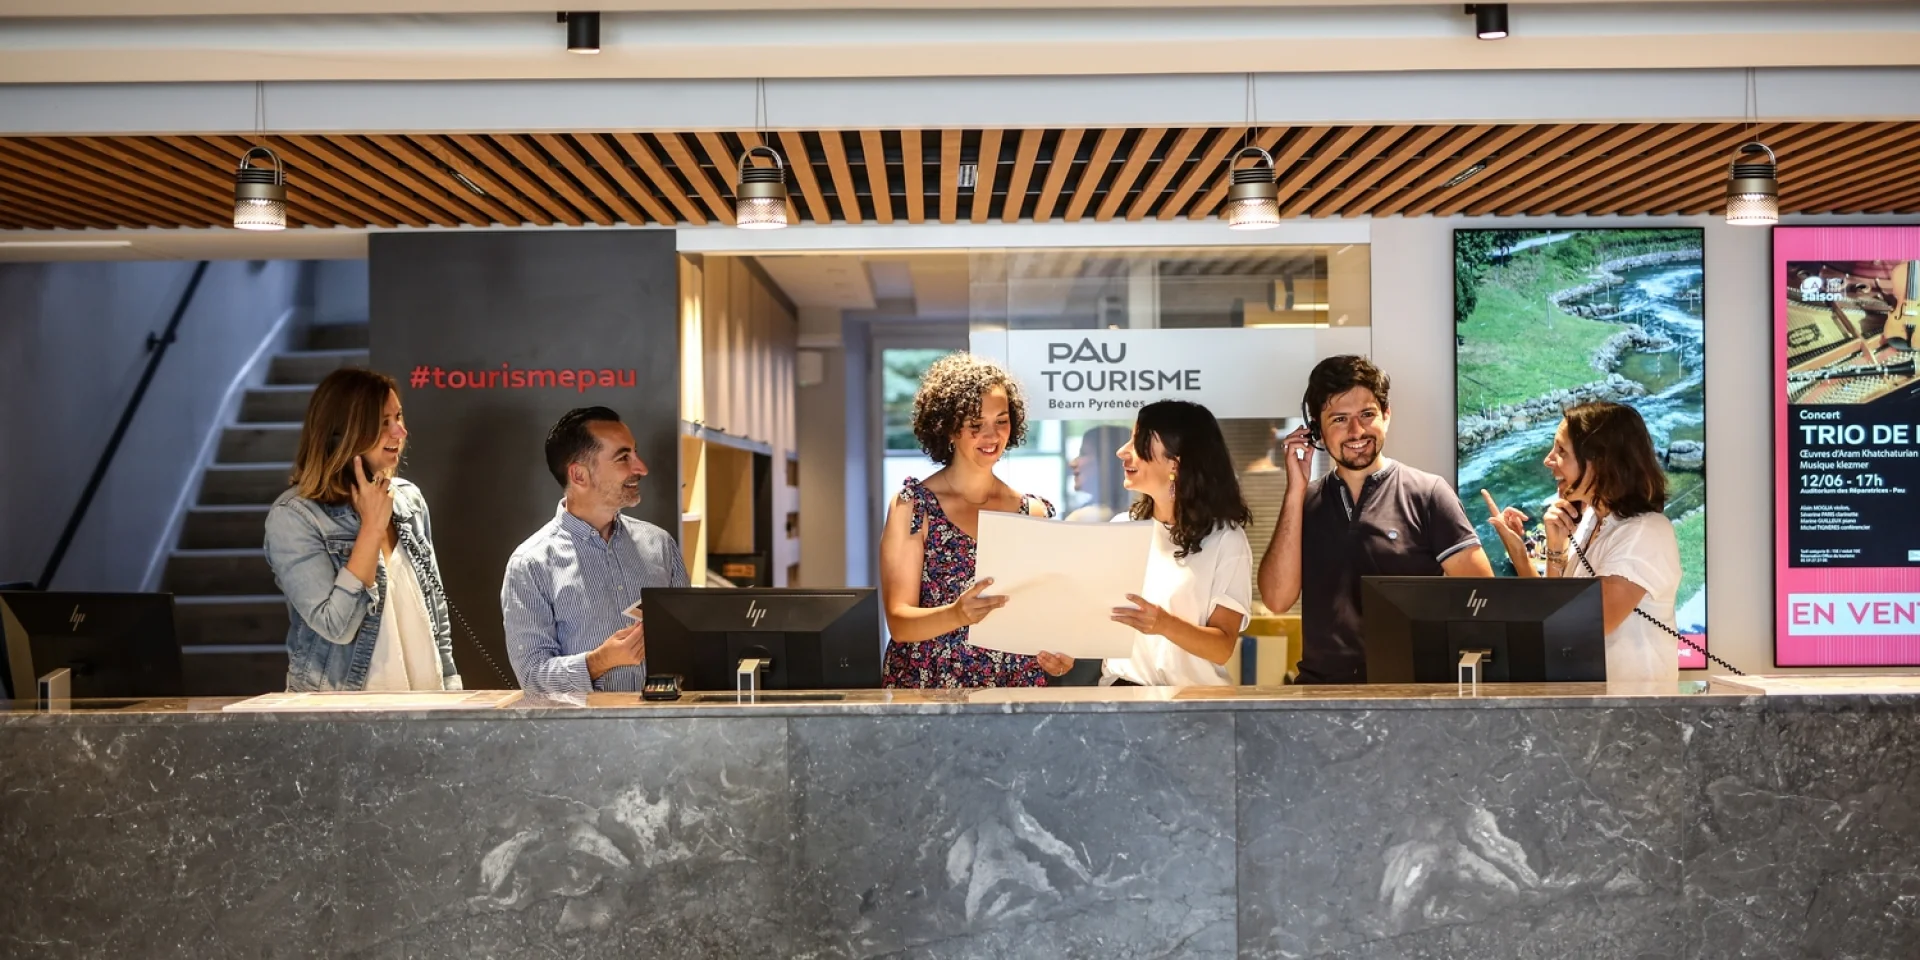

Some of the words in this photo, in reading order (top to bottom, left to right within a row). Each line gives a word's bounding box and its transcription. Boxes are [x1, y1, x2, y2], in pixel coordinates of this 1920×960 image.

[1801, 292, 1842, 301] saison
[1048, 338, 1126, 364] PAU
[410, 363, 637, 393] #tourismepau
[1041, 370, 1201, 392] TOURISME
[1049, 399, 1085, 409] Béarn
[1088, 399, 1146, 411] Pyrénées
[1799, 410, 1841, 420] Concert
[1799, 425, 1865, 444] TRIO
[1873, 425, 1909, 444] DE
[1799, 450, 1830, 458] Œuvres
[1800, 461, 1835, 470] Musique
[1836, 460, 1869, 469] klezmer
[1800, 474, 1843, 487] 12/06
[1855, 474, 1883, 487] 17h
[746, 599, 767, 627] hp
[1467, 589, 1488, 617] hp
[69, 604, 86, 632] hp
[1792, 602, 1835, 625] EN
